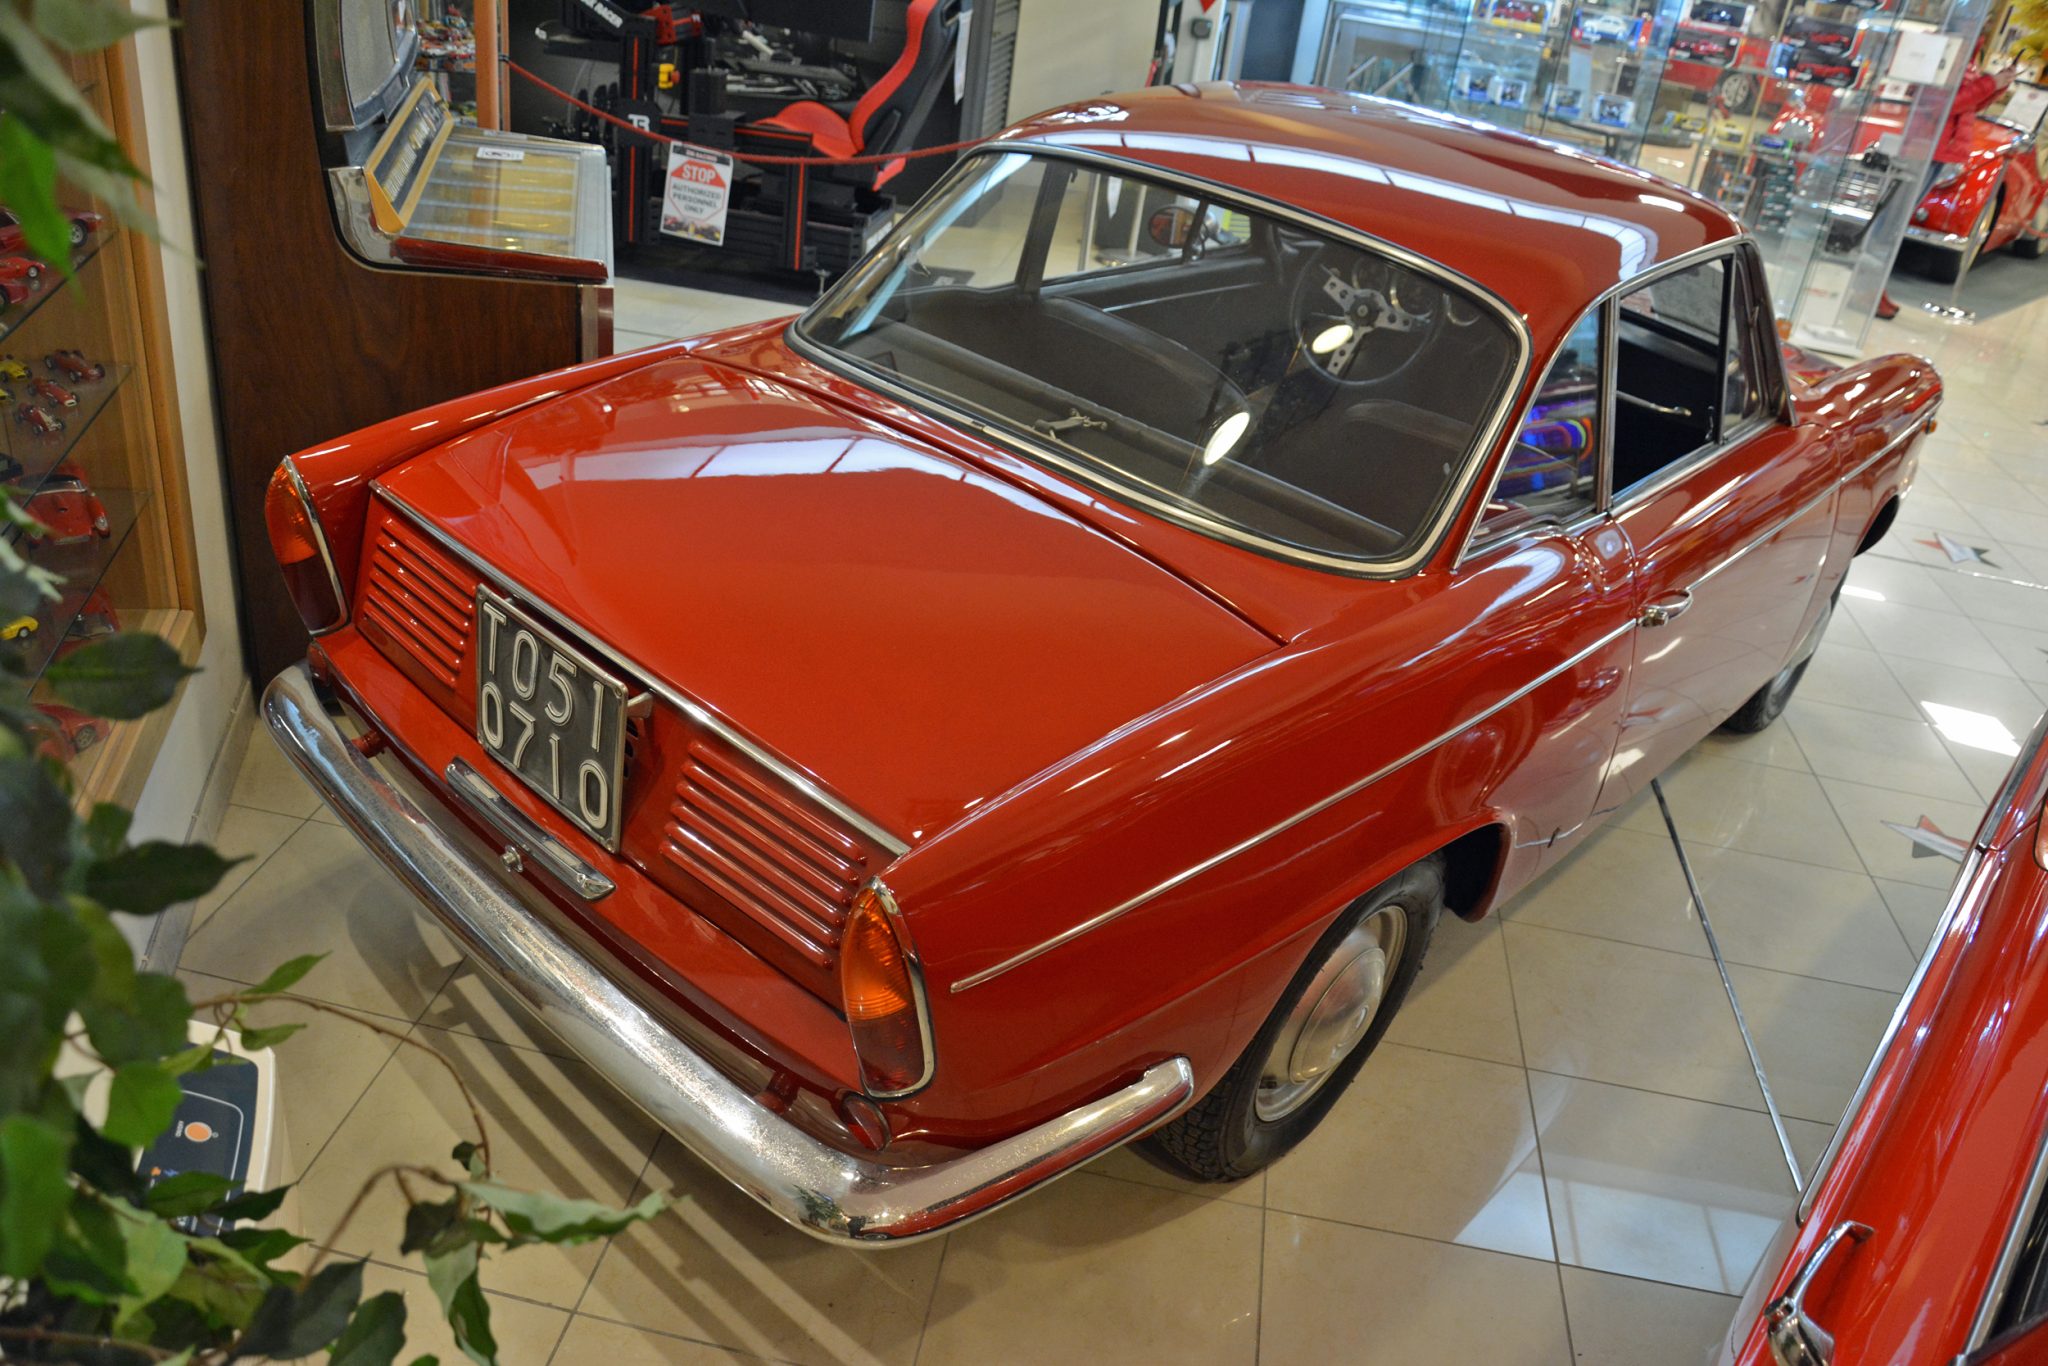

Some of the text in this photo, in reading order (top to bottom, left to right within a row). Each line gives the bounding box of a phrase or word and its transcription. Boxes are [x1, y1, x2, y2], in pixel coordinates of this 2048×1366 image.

[682, 164, 717, 184] STOP
[672, 184, 722, 200] AUTHORIZED
[672, 193, 718, 208] PERSONNEL
[684, 203, 705, 214] ONLY
[481, 681, 609, 830] 0710
